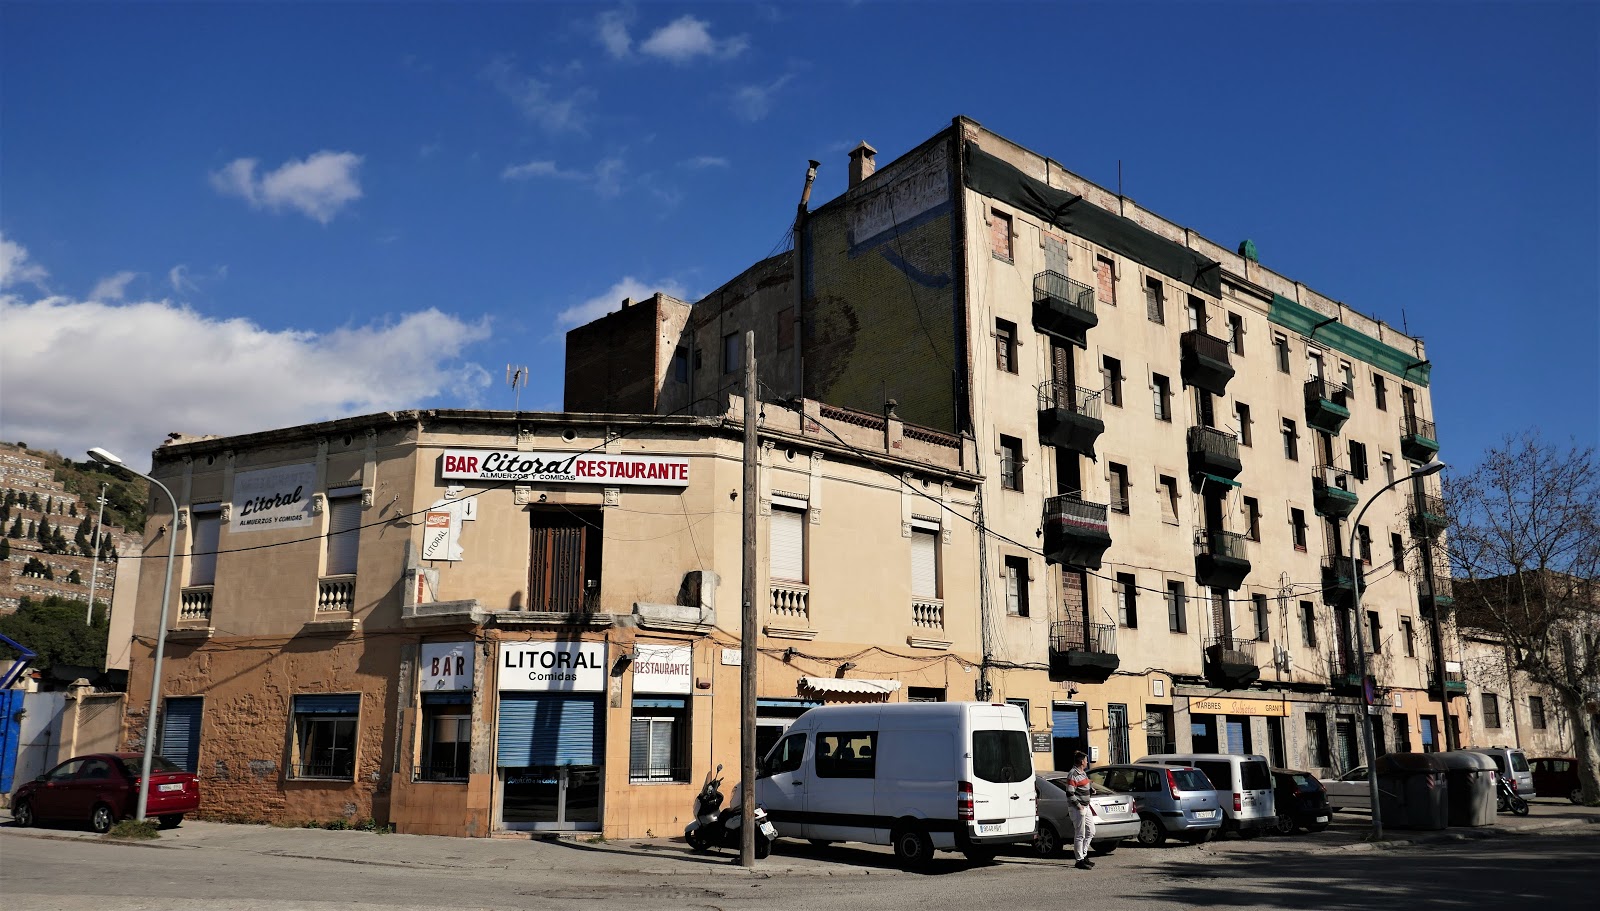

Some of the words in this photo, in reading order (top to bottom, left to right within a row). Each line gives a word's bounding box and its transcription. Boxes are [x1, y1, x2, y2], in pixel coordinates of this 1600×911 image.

[445, 455, 478, 473] BAR
[481, 452, 577, 475] Litoral
[575, 460, 689, 480] RESTAURANTE
[480, 472, 528, 480] ALMUERZOS
[240, 485, 303, 517] Litoral
[239, 517, 273, 526] ALMUERZOS
[279, 514, 303, 523] COMIDAS
[424, 530, 448, 557] LITORAL
[431, 656, 465, 677] BAR
[505, 651, 602, 669] LITORAL
[528, 671, 577, 681] Comidas
[634, 661, 690, 676] RESTAURANTE
[1195, 701, 1222, 710] MARBRES
